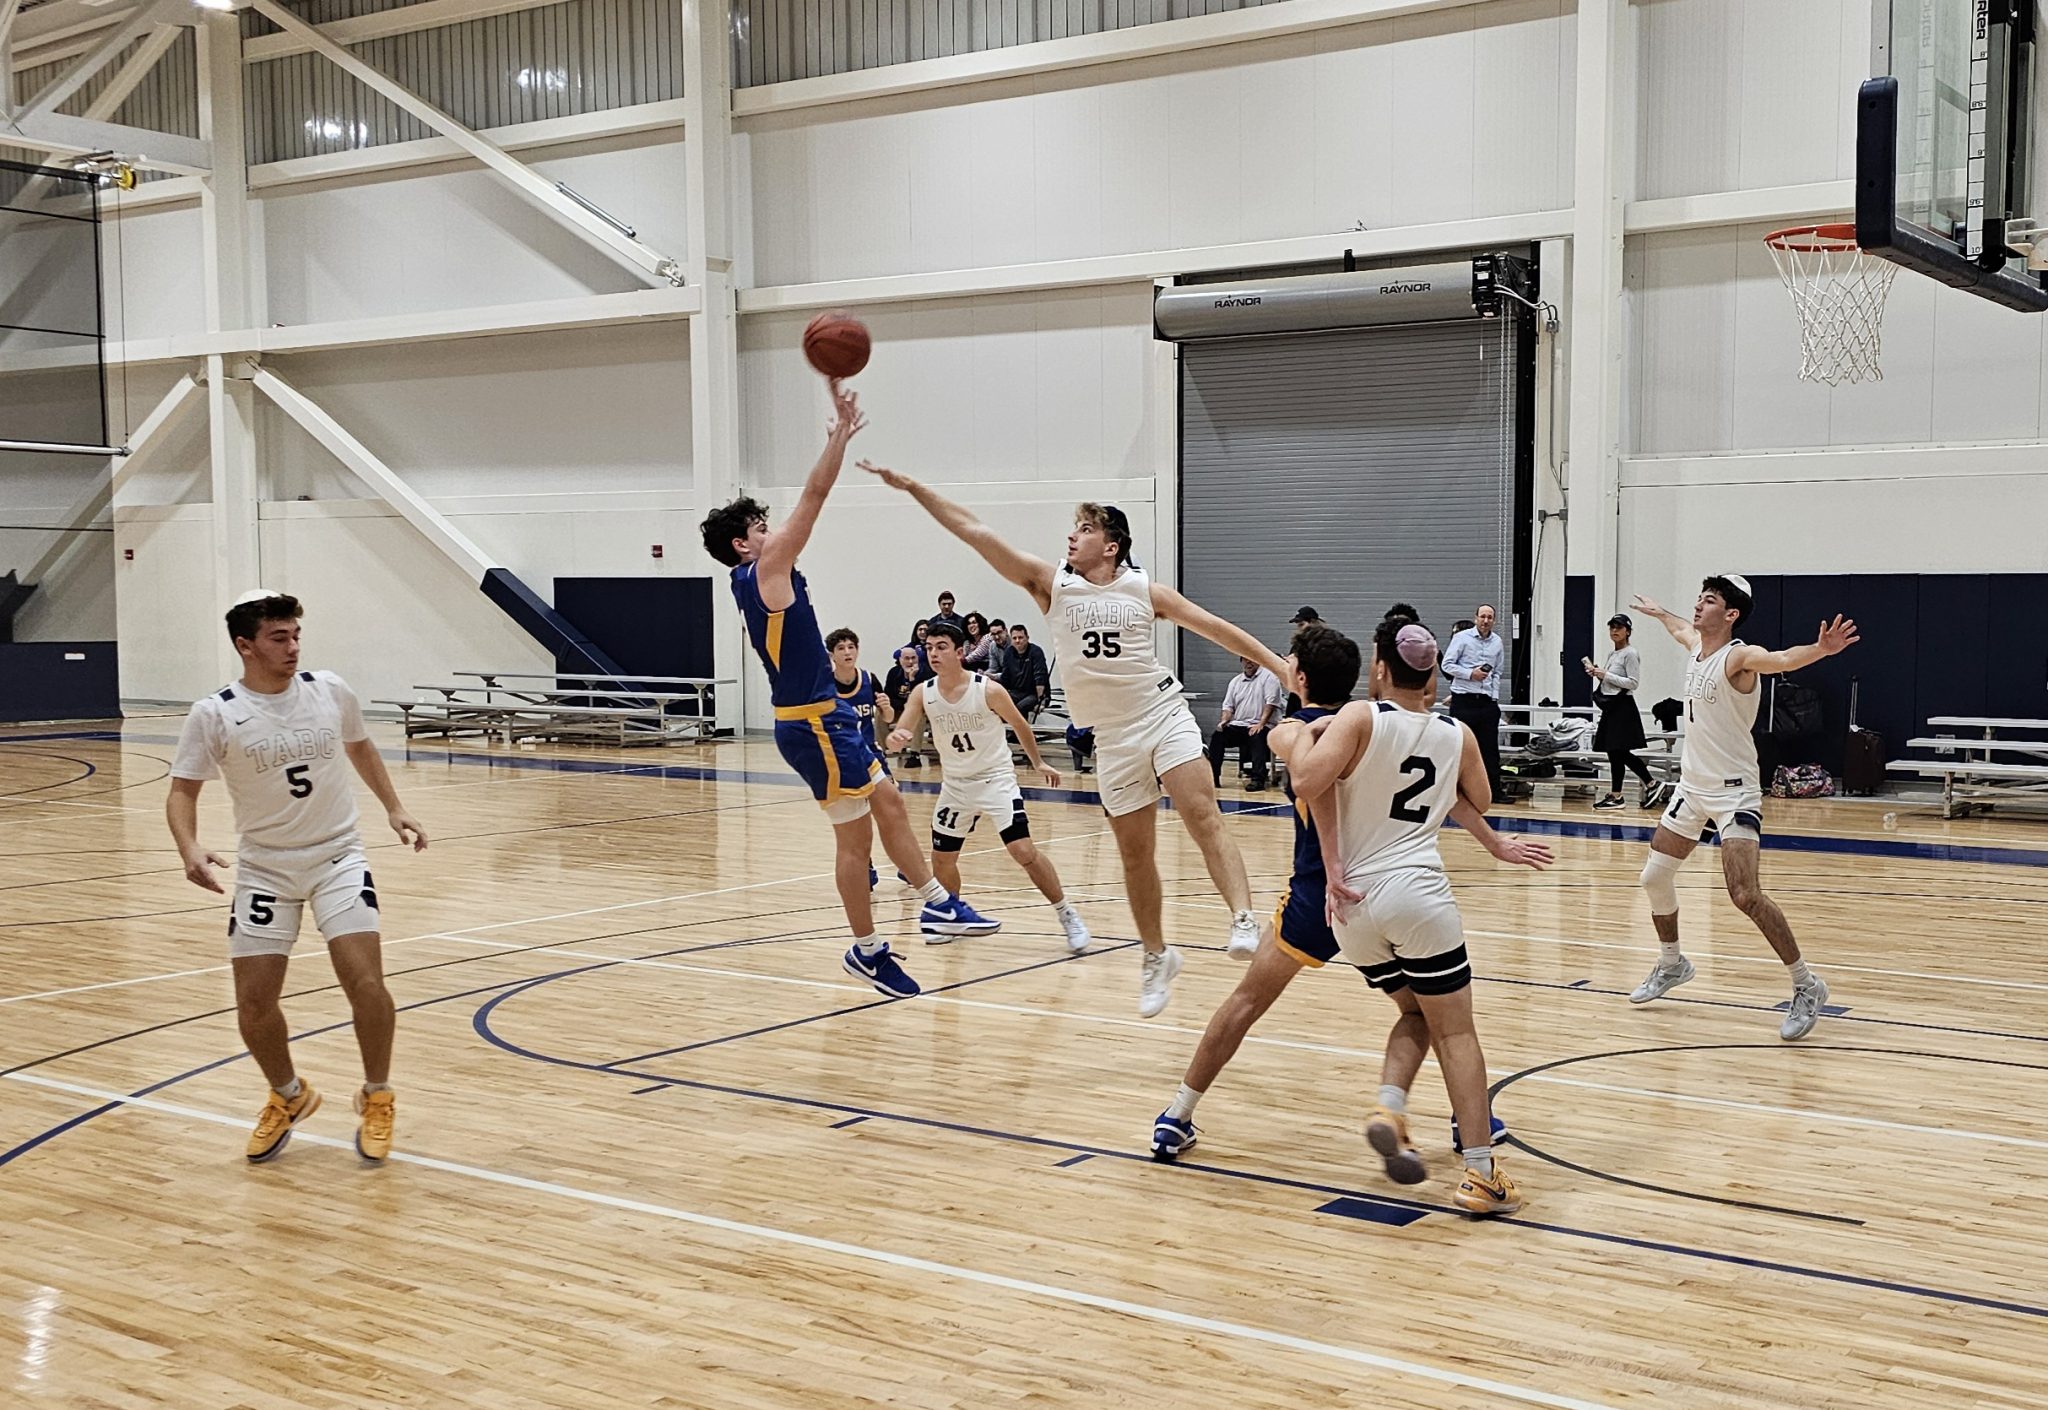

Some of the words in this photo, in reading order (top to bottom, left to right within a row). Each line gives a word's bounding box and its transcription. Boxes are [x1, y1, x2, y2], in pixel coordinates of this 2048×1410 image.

[1380, 283, 1431, 294] RAYNOR
[1214, 297, 1261, 308] RAYNOR
[1066, 601, 1138, 632] TABC
[1082, 631, 1121, 658] 35
[934, 712, 985, 735] TABC
[245, 728, 337, 773] TABC
[951, 732, 975, 752] 41
[285, 764, 313, 799] 5
[1389, 755, 1437, 823] 2
[937, 806, 960, 829] 41
[1668, 798, 1685, 819] 1
[249, 893, 277, 926] 5
